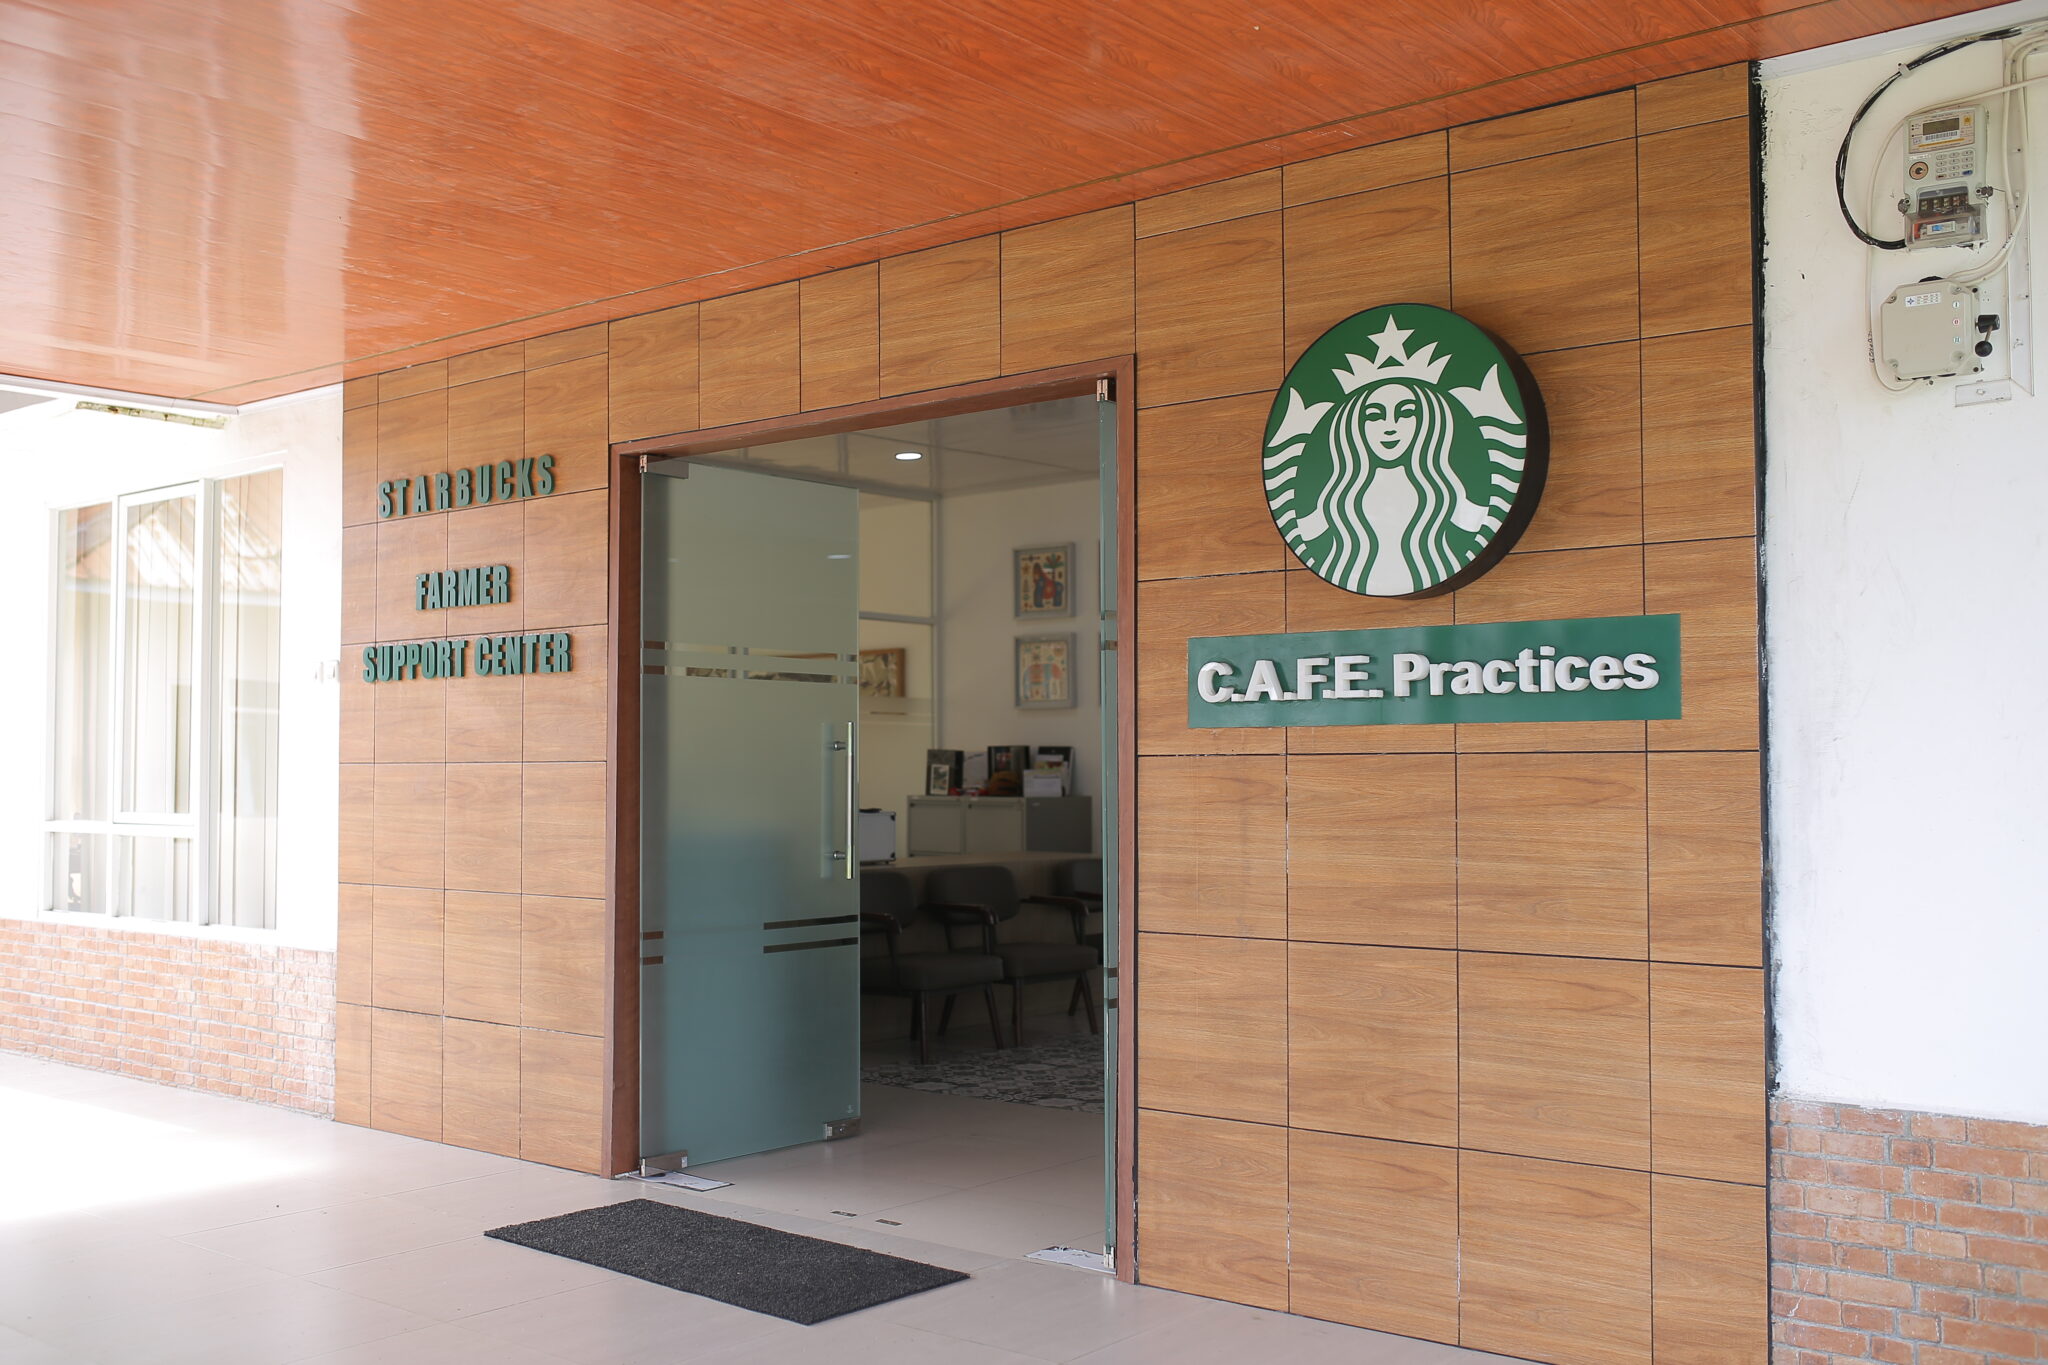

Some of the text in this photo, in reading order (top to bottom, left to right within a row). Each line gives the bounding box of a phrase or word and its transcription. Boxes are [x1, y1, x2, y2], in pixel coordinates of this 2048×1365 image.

[378, 454, 555, 518] STARBUCKS
[415, 564, 512, 611] FARMER
[362, 632, 573, 683] SUPPORT CENTER
[1197, 645, 1660, 704] C.A.F.E. Practices
